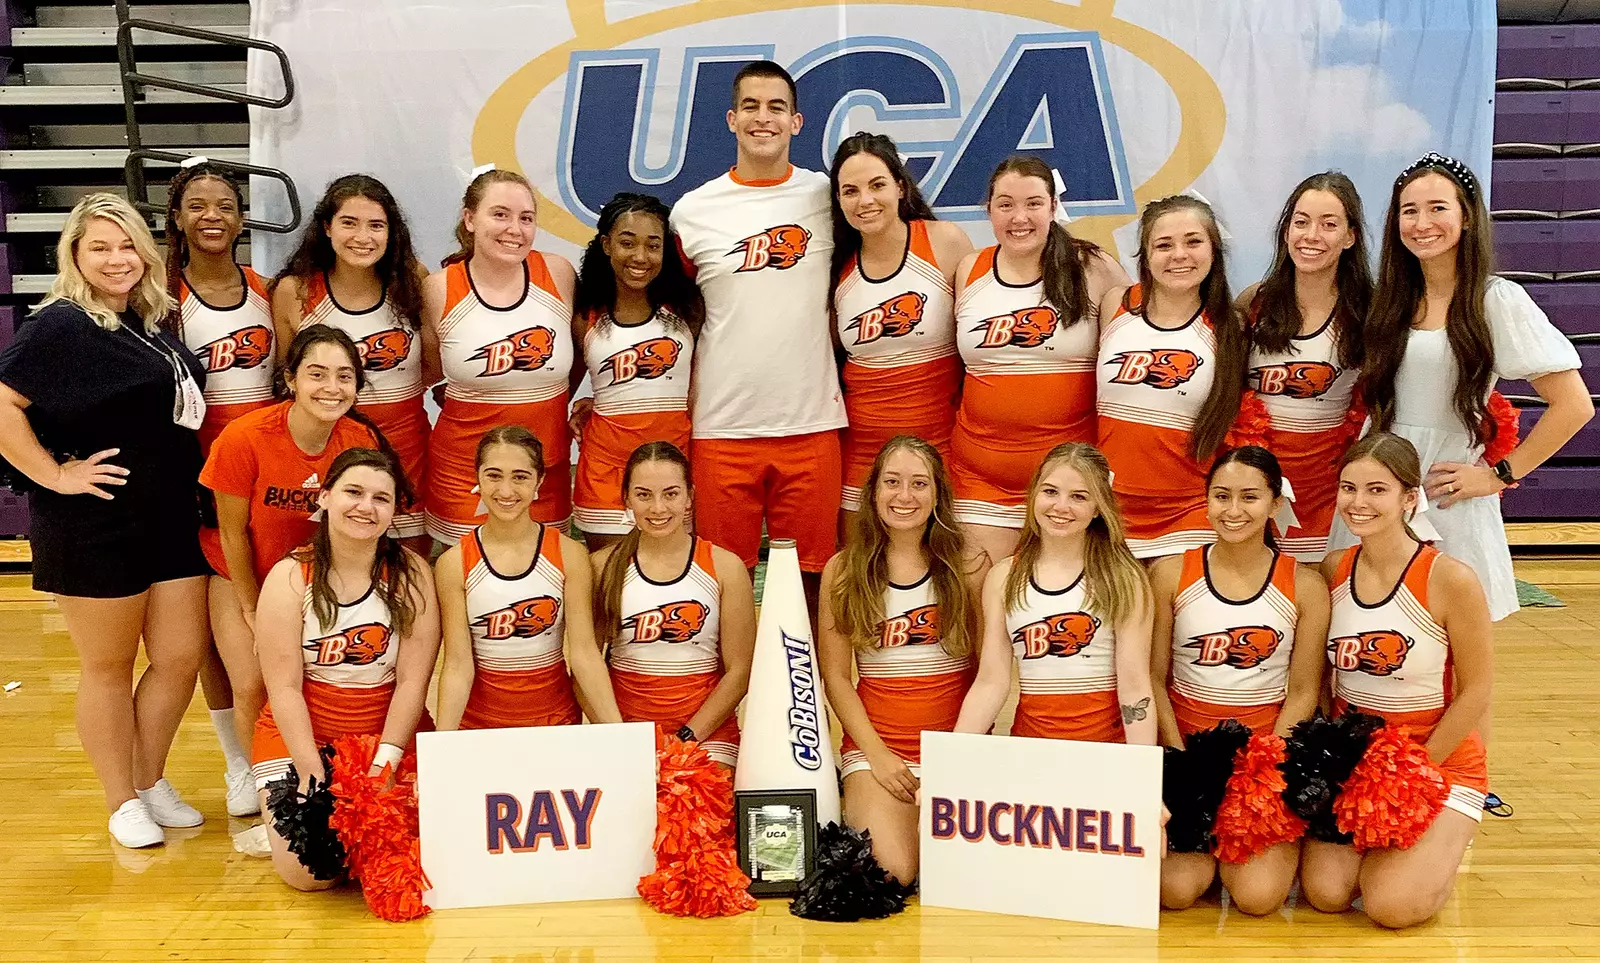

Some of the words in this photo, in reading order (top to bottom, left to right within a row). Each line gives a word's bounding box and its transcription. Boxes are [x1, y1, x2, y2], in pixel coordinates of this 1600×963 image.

[557, 31, 1136, 226] UCA
[739, 233, 772, 271] B
[856, 307, 885, 343] B
[980, 314, 1017, 348] B
[209, 336, 237, 372] B
[483, 339, 515, 375] B
[611, 348, 639, 385] B
[1113, 352, 1155, 384] B
[1258, 366, 1288, 394] B
[487, 608, 517, 639] B
[632, 609, 664, 642] B
[882, 615, 911, 648] B
[1024, 621, 1051, 658] B
[317, 634, 348, 666] B
[1199, 632, 1232, 666] B
[1336, 637, 1362, 671] B
[485, 788, 603, 854] RAY
[931, 797, 1145, 857] BUCKNELL
